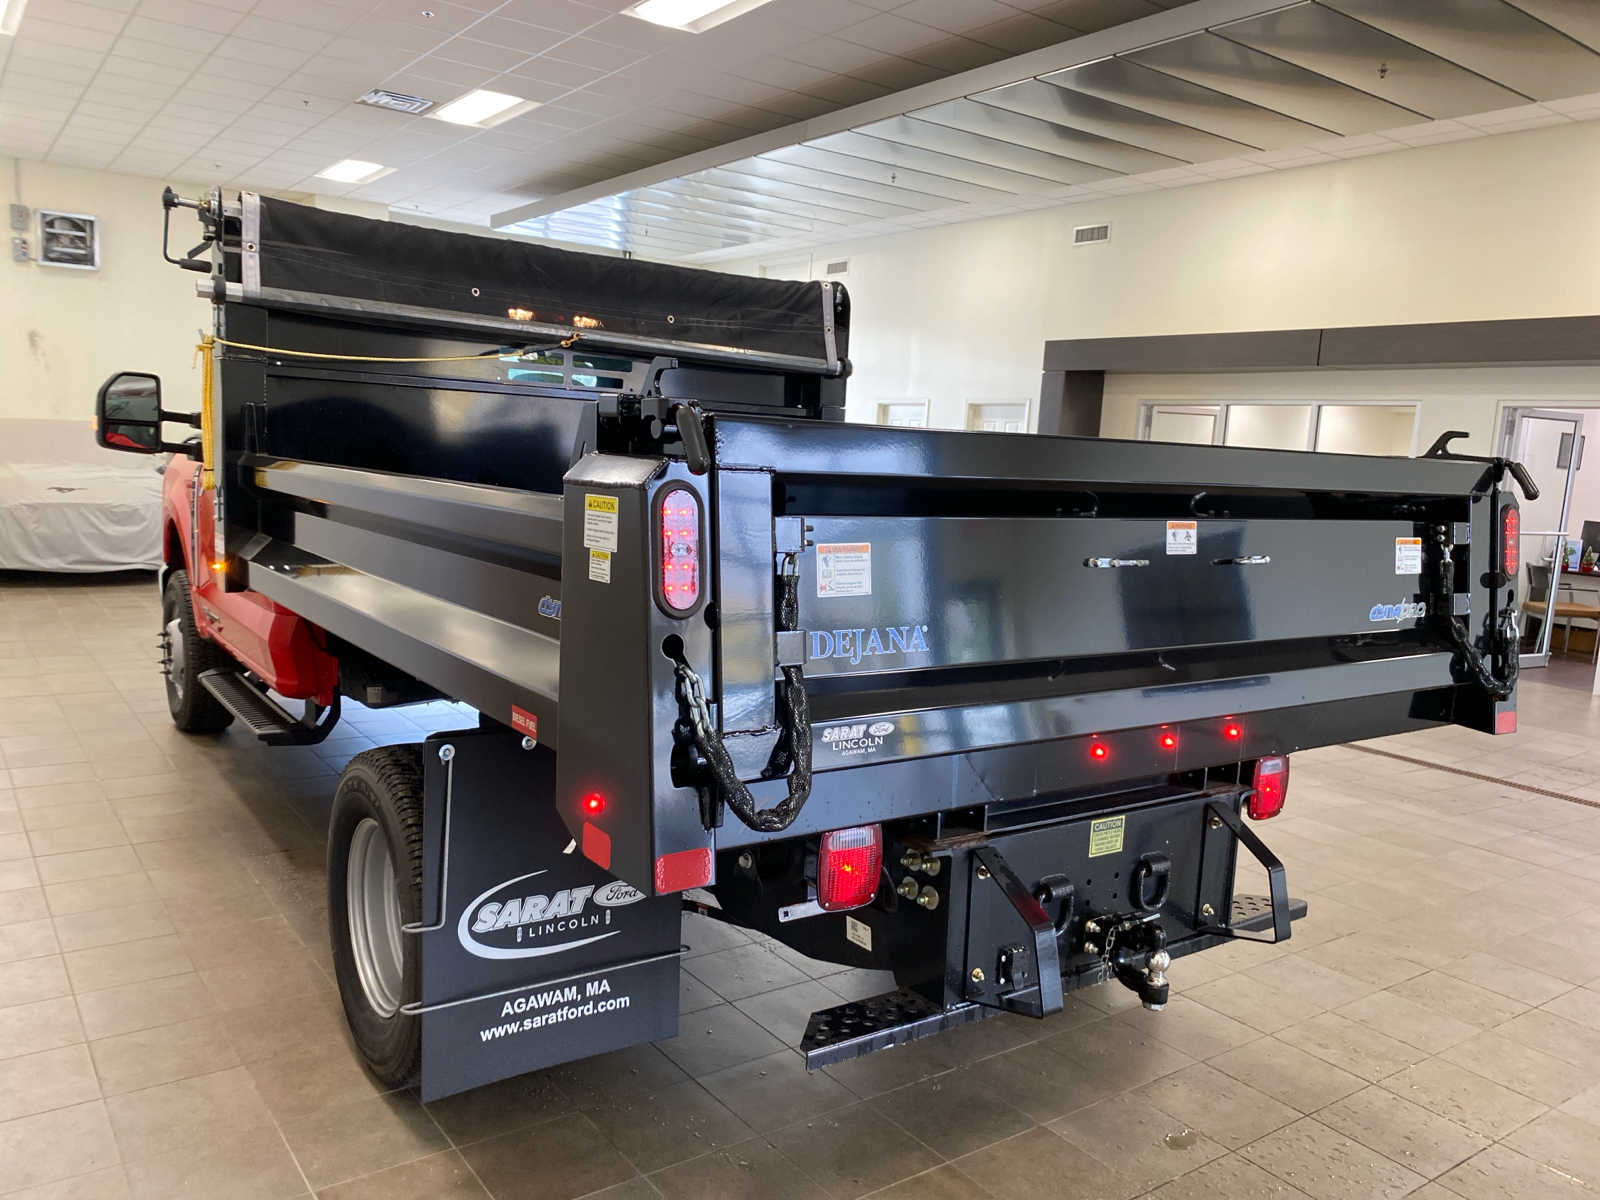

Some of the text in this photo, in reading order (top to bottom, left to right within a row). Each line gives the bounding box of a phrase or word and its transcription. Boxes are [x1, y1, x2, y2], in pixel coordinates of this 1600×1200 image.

[593, 500, 615, 511] CAUTION
[832, 545, 862, 553] WARNING
[810, 625, 929, 665] DEJANA
[512, 711, 536, 732] DIESEL FUEL
[821, 724, 867, 743] SARAT
[832, 736, 884, 751] LINCOLN
[842, 748, 867, 756] AGAWAM,
[1094, 820, 1121, 830] CAUTION
[471, 884, 639, 933] SARAT Ford
[528, 914, 600, 937] LINCOLN
[501, 979, 611, 1017] AGAWAM, MA
[479, 995, 630, 1042] www.saratford.com
